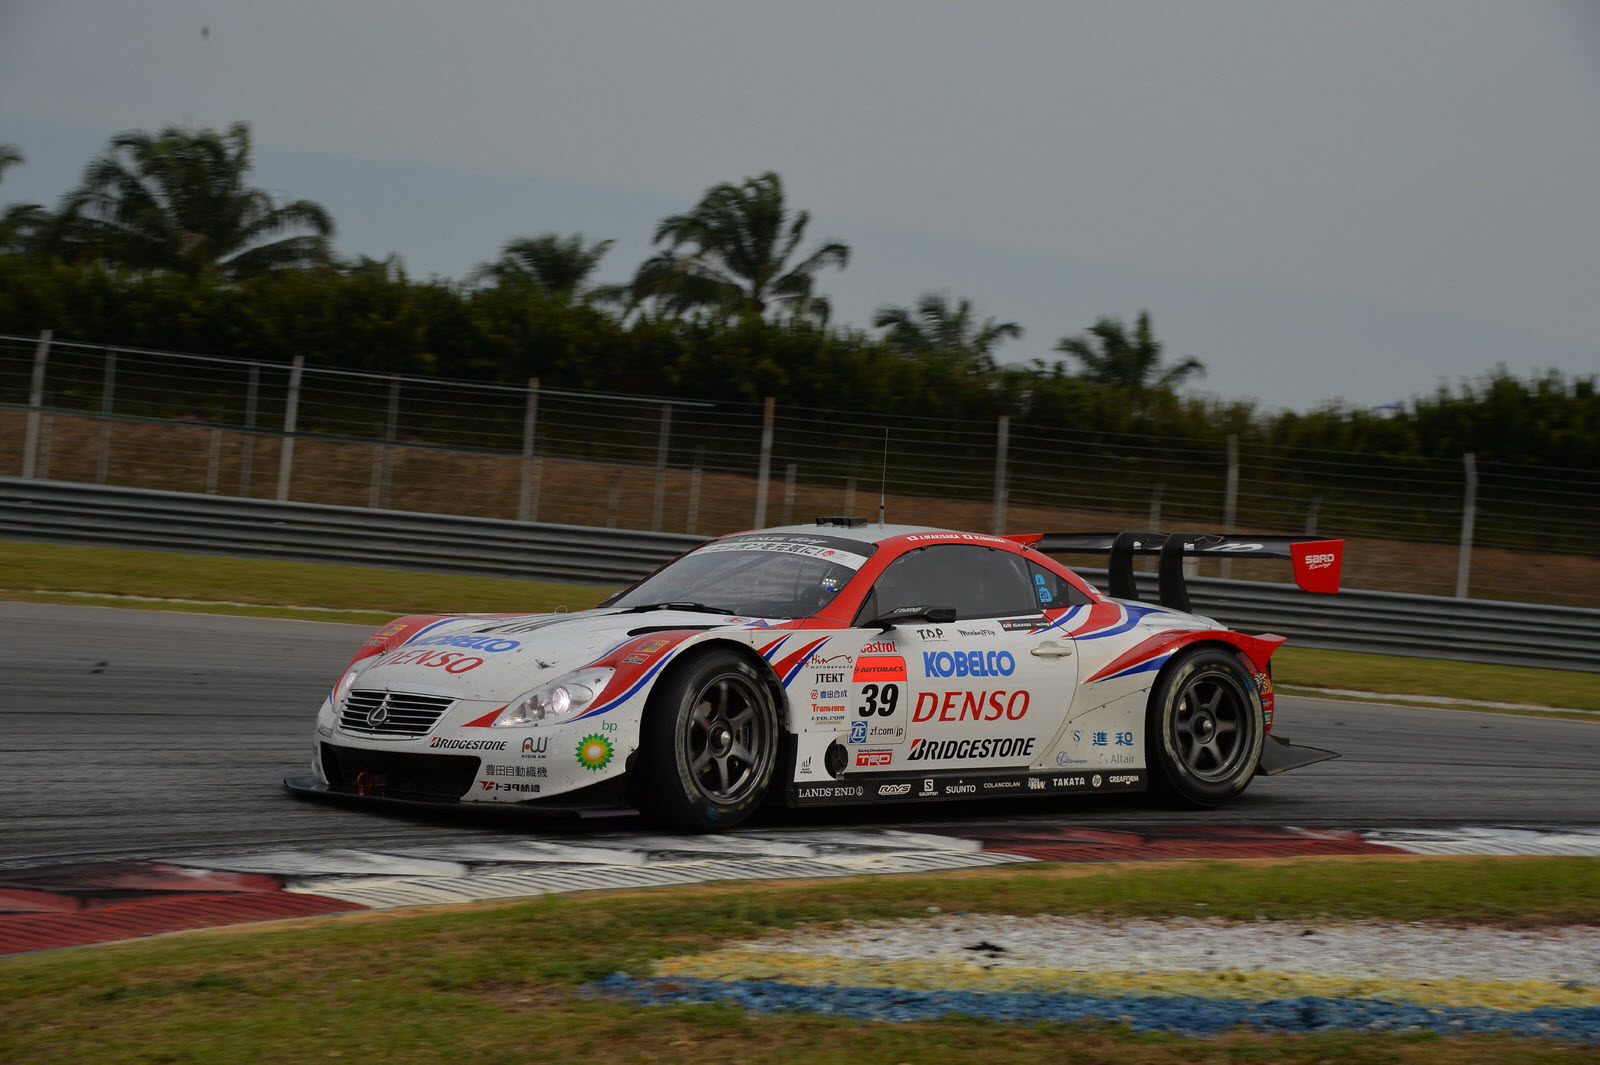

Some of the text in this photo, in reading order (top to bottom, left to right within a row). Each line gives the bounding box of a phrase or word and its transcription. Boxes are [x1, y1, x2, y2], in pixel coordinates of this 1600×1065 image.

[1305, 553, 1335, 564] SARD
[1308, 562, 1331, 570] Racing
[370, 649, 484, 674] DENSO
[922, 650, 1016, 678] KOBELCO
[815, 673, 845, 685] JTEKT
[858, 683, 899, 718] 39
[912, 690, 1031, 723] DENSO
[602, 720, 618, 733] bp
[870, 726, 904, 737] zf.com/jp
[430, 737, 509, 750] BRIDGESTONE
[1092, 731, 1134, 746] 進和
[907, 737, 1036, 761] BRIDGESTONE
[858, 754, 891, 767] TRD
[1110, 754, 1136, 764] Altair
[486, 764, 548, 778] 豊田自動織機
[1053, 777, 1086, 787] TAKATA
[1109, 774, 1140, 785] CREAFORM
[834, 786, 856, 796] END
[879, 783, 912, 796] RAYS
[946, 784, 977, 794] SUUNTO
